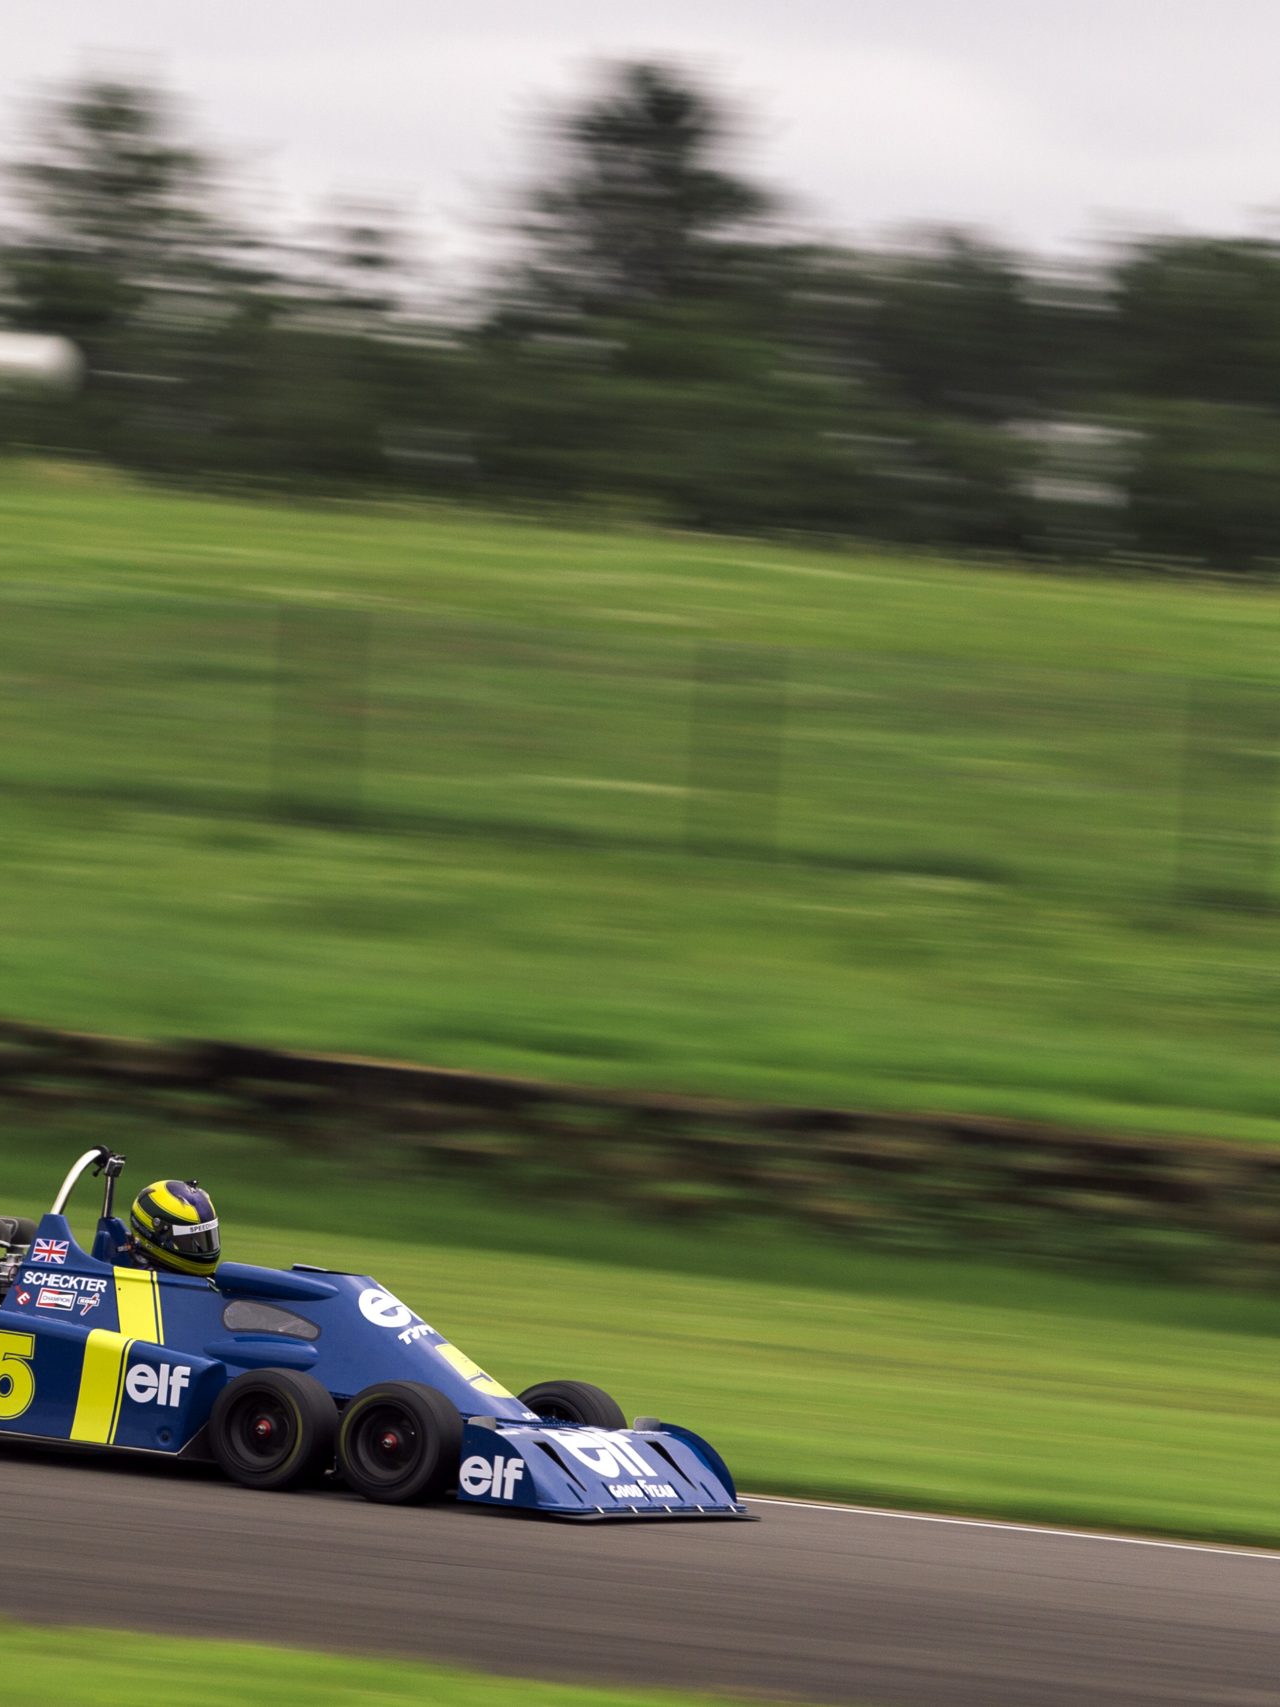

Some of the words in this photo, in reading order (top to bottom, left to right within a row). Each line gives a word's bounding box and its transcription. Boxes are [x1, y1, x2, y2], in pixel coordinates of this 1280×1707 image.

[22, 1271, 108, 1293] SCHECKTER
[125, 1363, 191, 1408] elf
[539, 1427, 658, 1479] elf
[458, 1455, 524, 1501] elf
